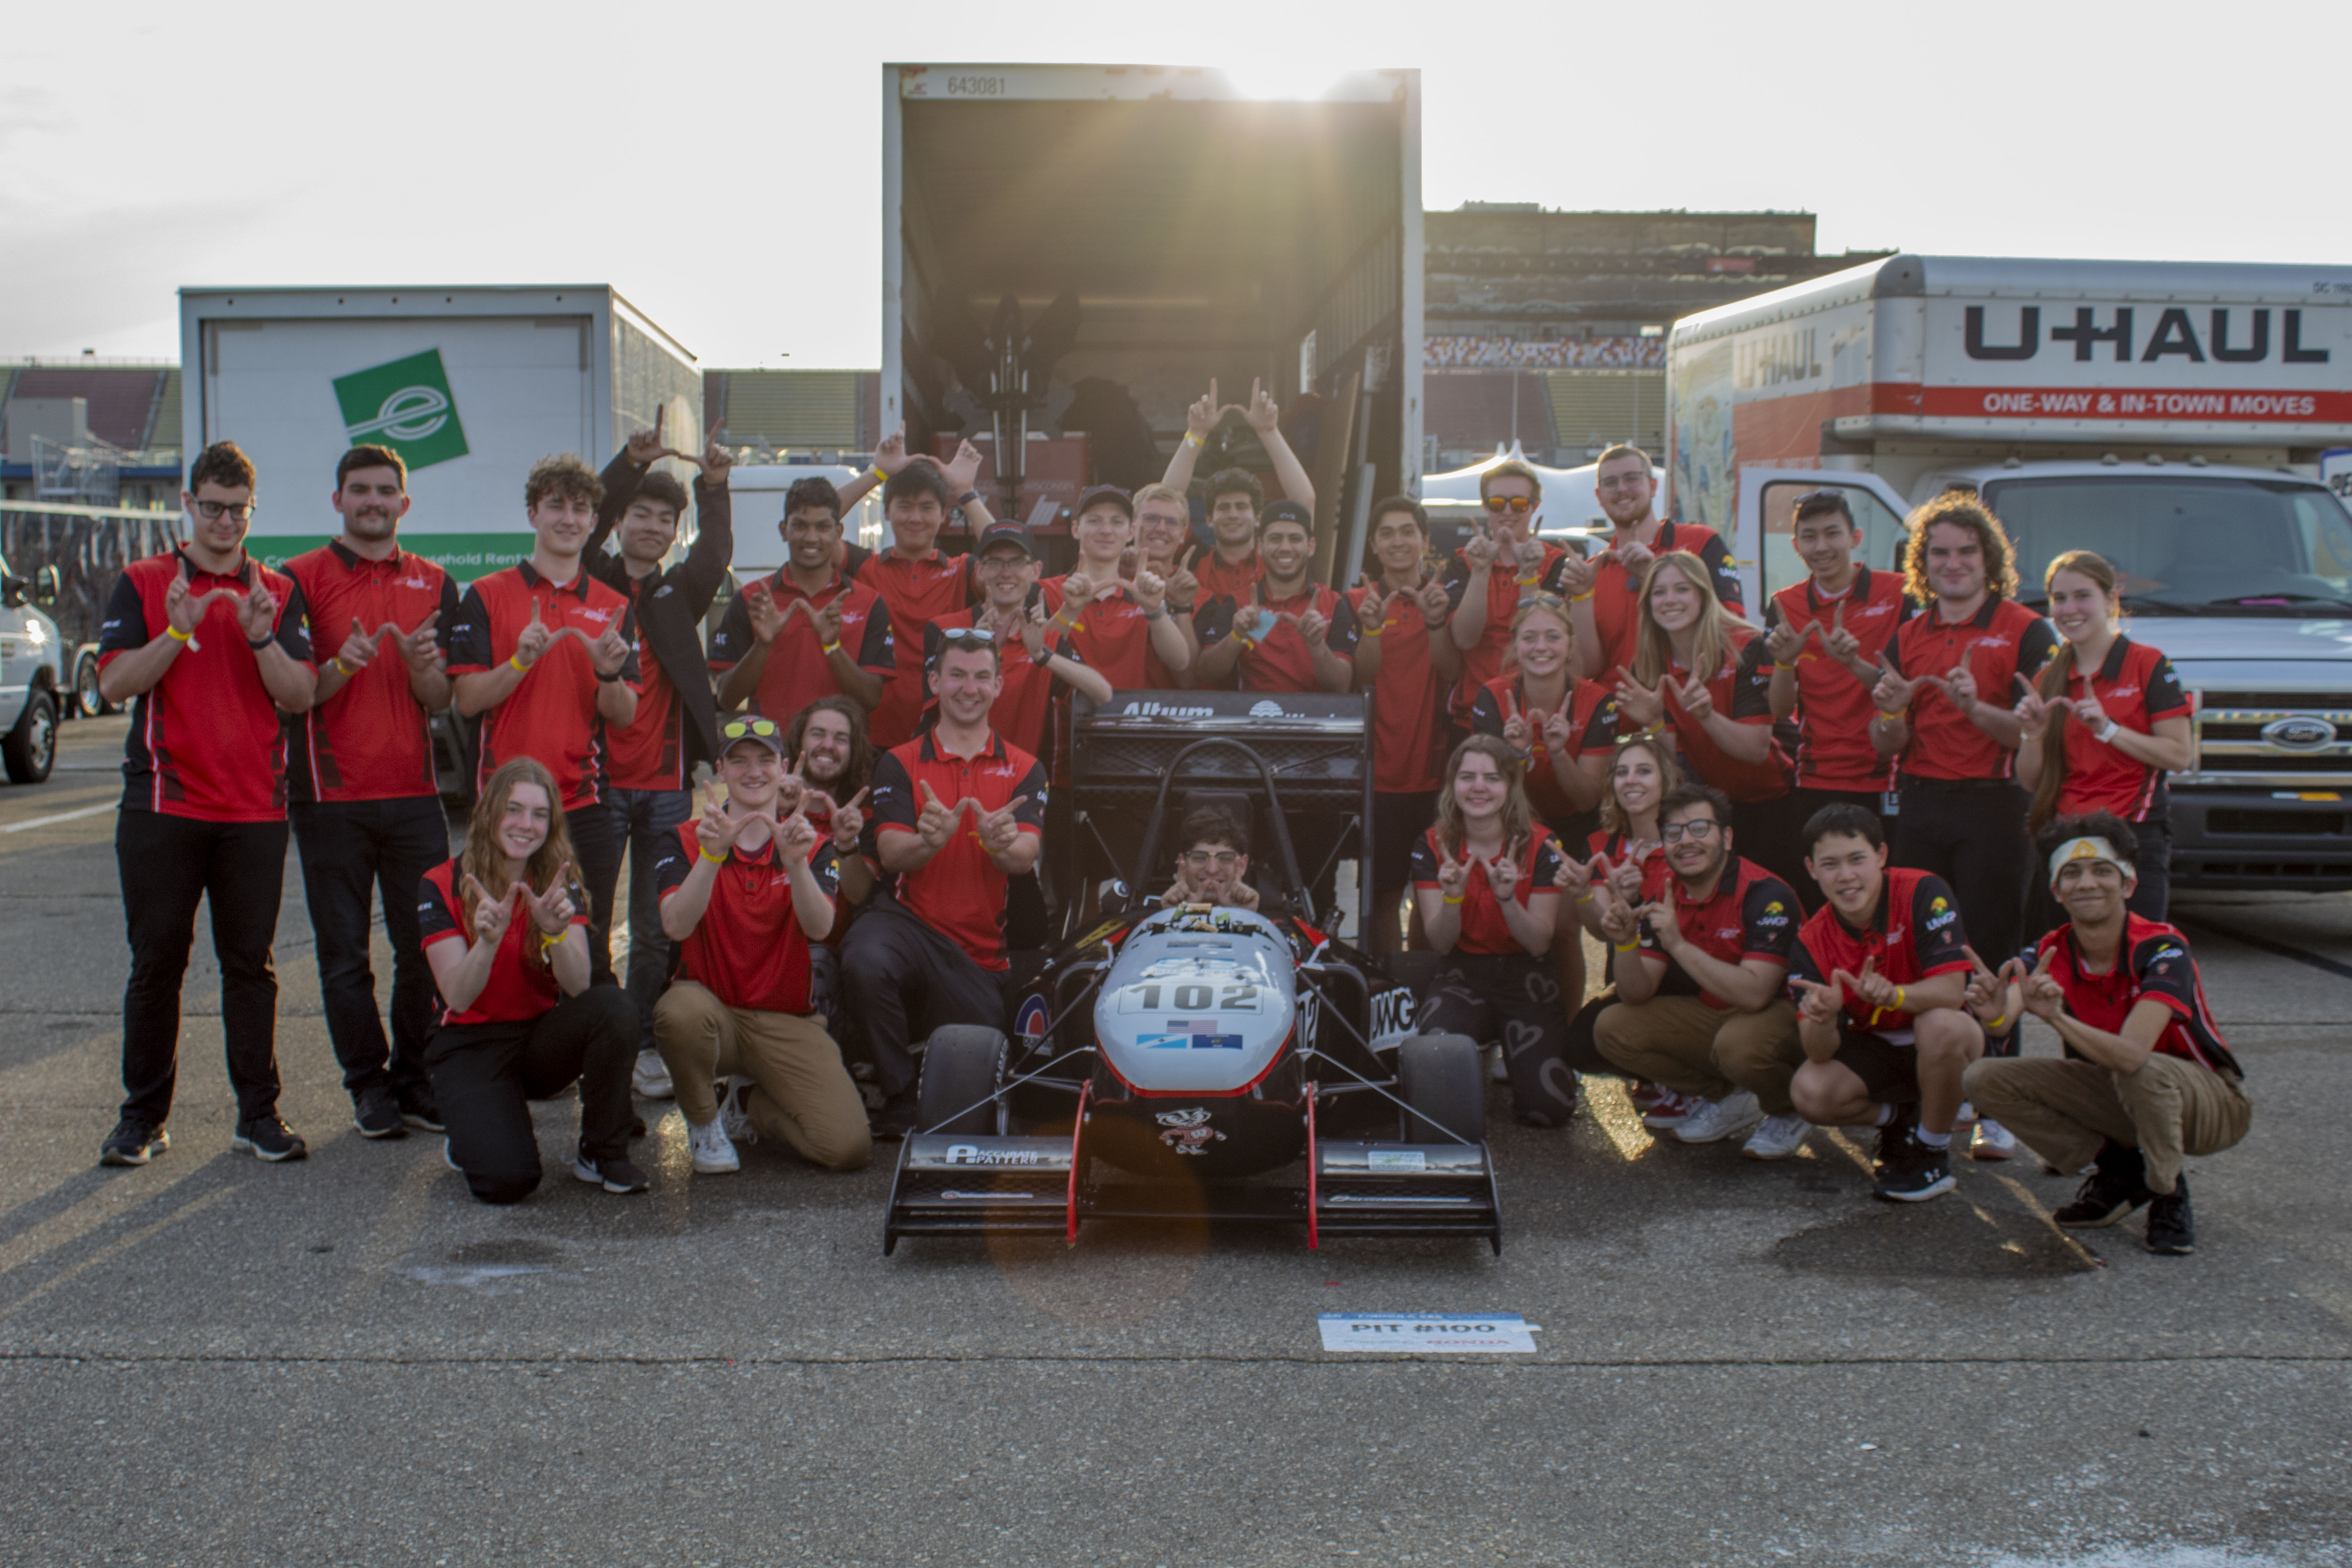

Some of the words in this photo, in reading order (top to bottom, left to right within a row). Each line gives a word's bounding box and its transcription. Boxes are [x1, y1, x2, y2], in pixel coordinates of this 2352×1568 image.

[947, 76, 1006, 94] 643081
[1965, 306, 2330, 363] U-HAUL
[1984, 393, 2093, 413] ONE-WAY
[2097, 394, 2116, 413] &
[2121, 393, 2225, 415] IN-TOWN
[2230, 395, 2315, 416] MOVES
[1128, 984, 1258, 1011] 102
[976, 1155, 1038, 1164] PATTERN
[977, 1149, 1039, 1158] ACCURATE
[1352, 1324, 1403, 1333] PIT
[1413, 1324, 1496, 1333] #100
